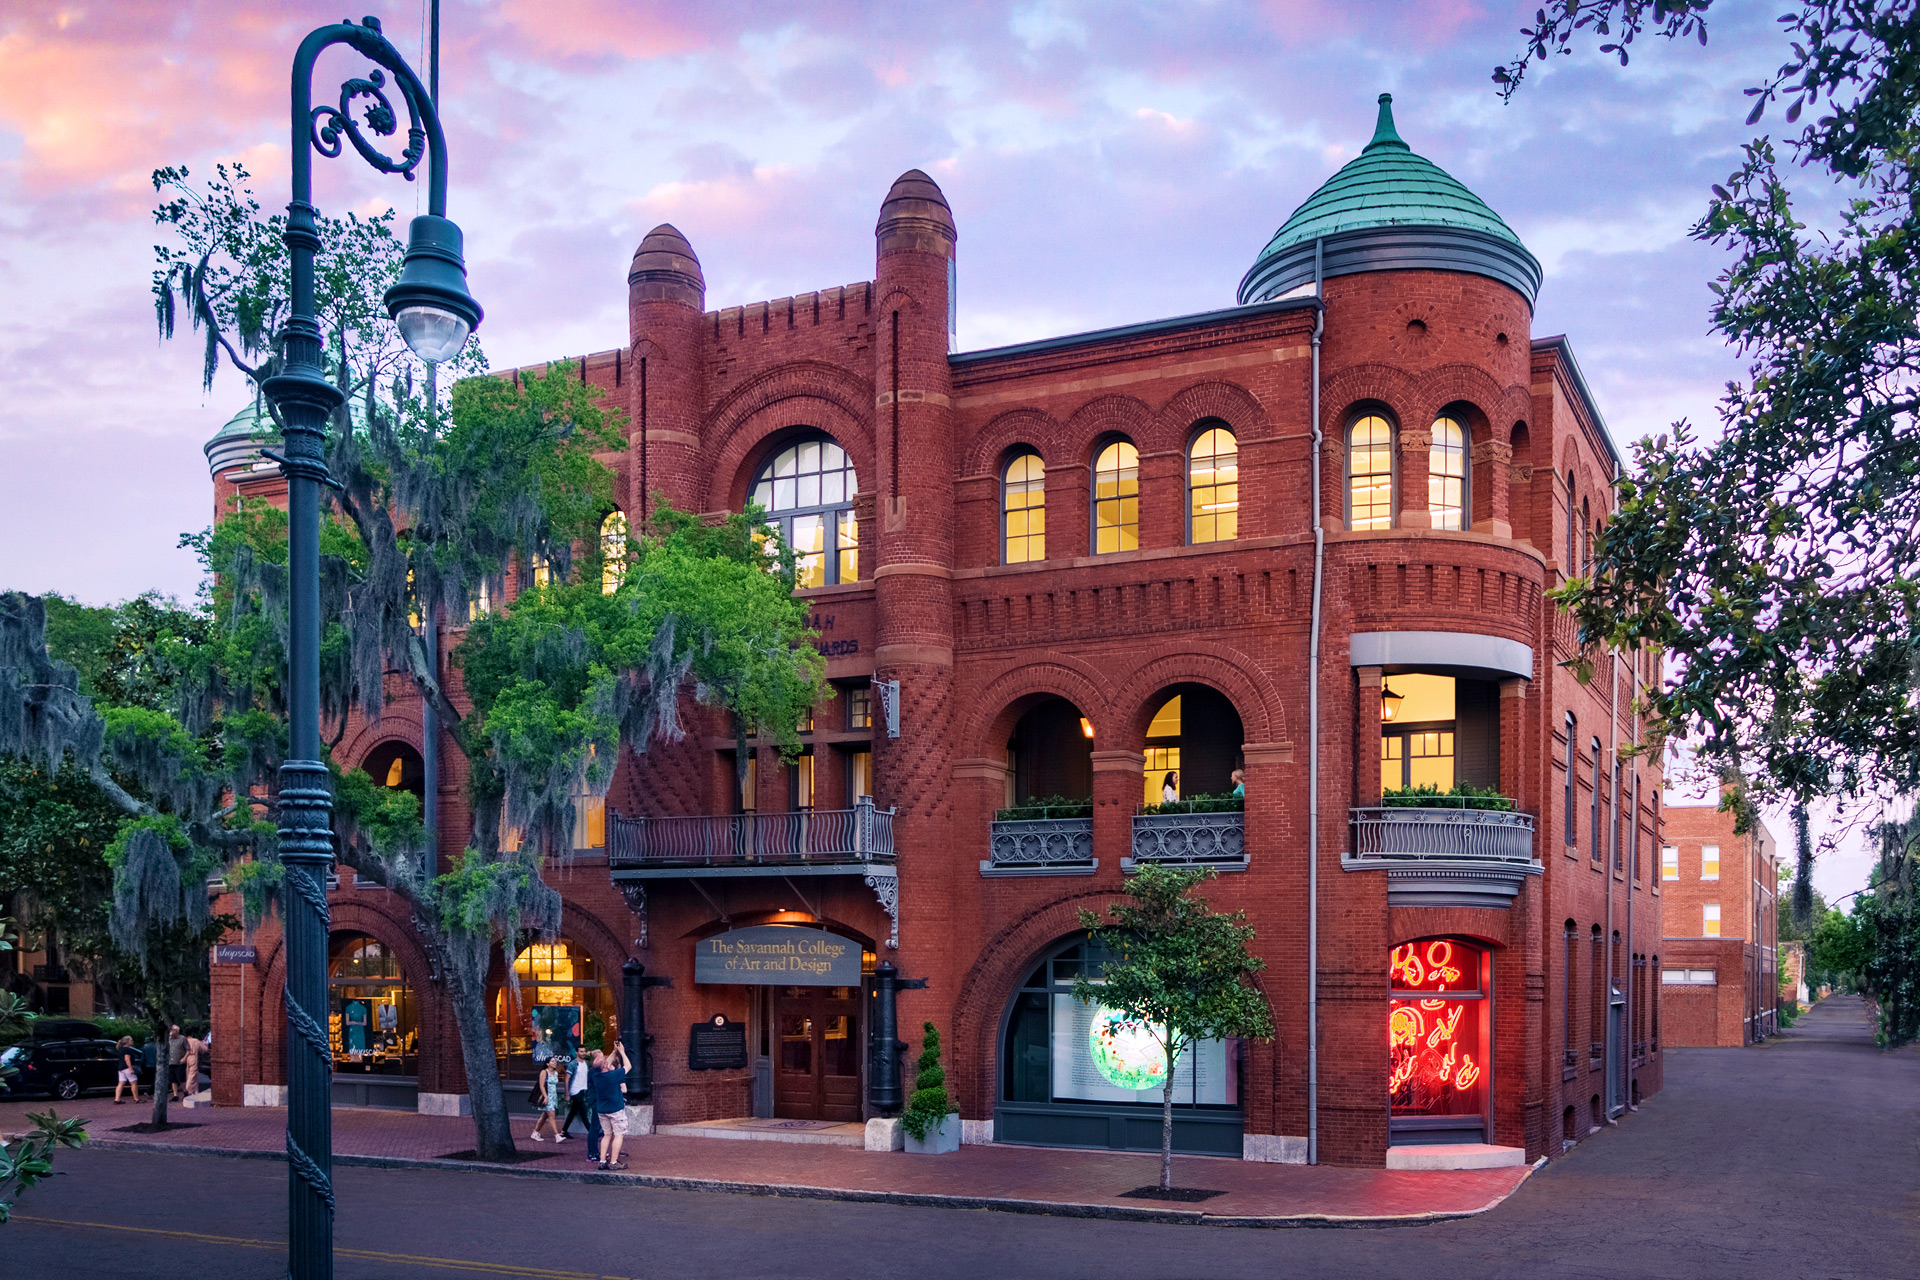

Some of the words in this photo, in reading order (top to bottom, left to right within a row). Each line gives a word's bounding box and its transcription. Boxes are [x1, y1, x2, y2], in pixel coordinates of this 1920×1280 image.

[813, 640, 859, 657] UARDS
[218, 947, 255, 960] shopSCAD
[710, 939, 735, 954] The
[736, 939, 795, 954] Savannah
[798, 940, 846, 958] College
[725, 956, 739, 970] of
[740, 957, 761, 971] Art
[763, 957, 786, 971] and
[789, 957, 832, 974] Design
